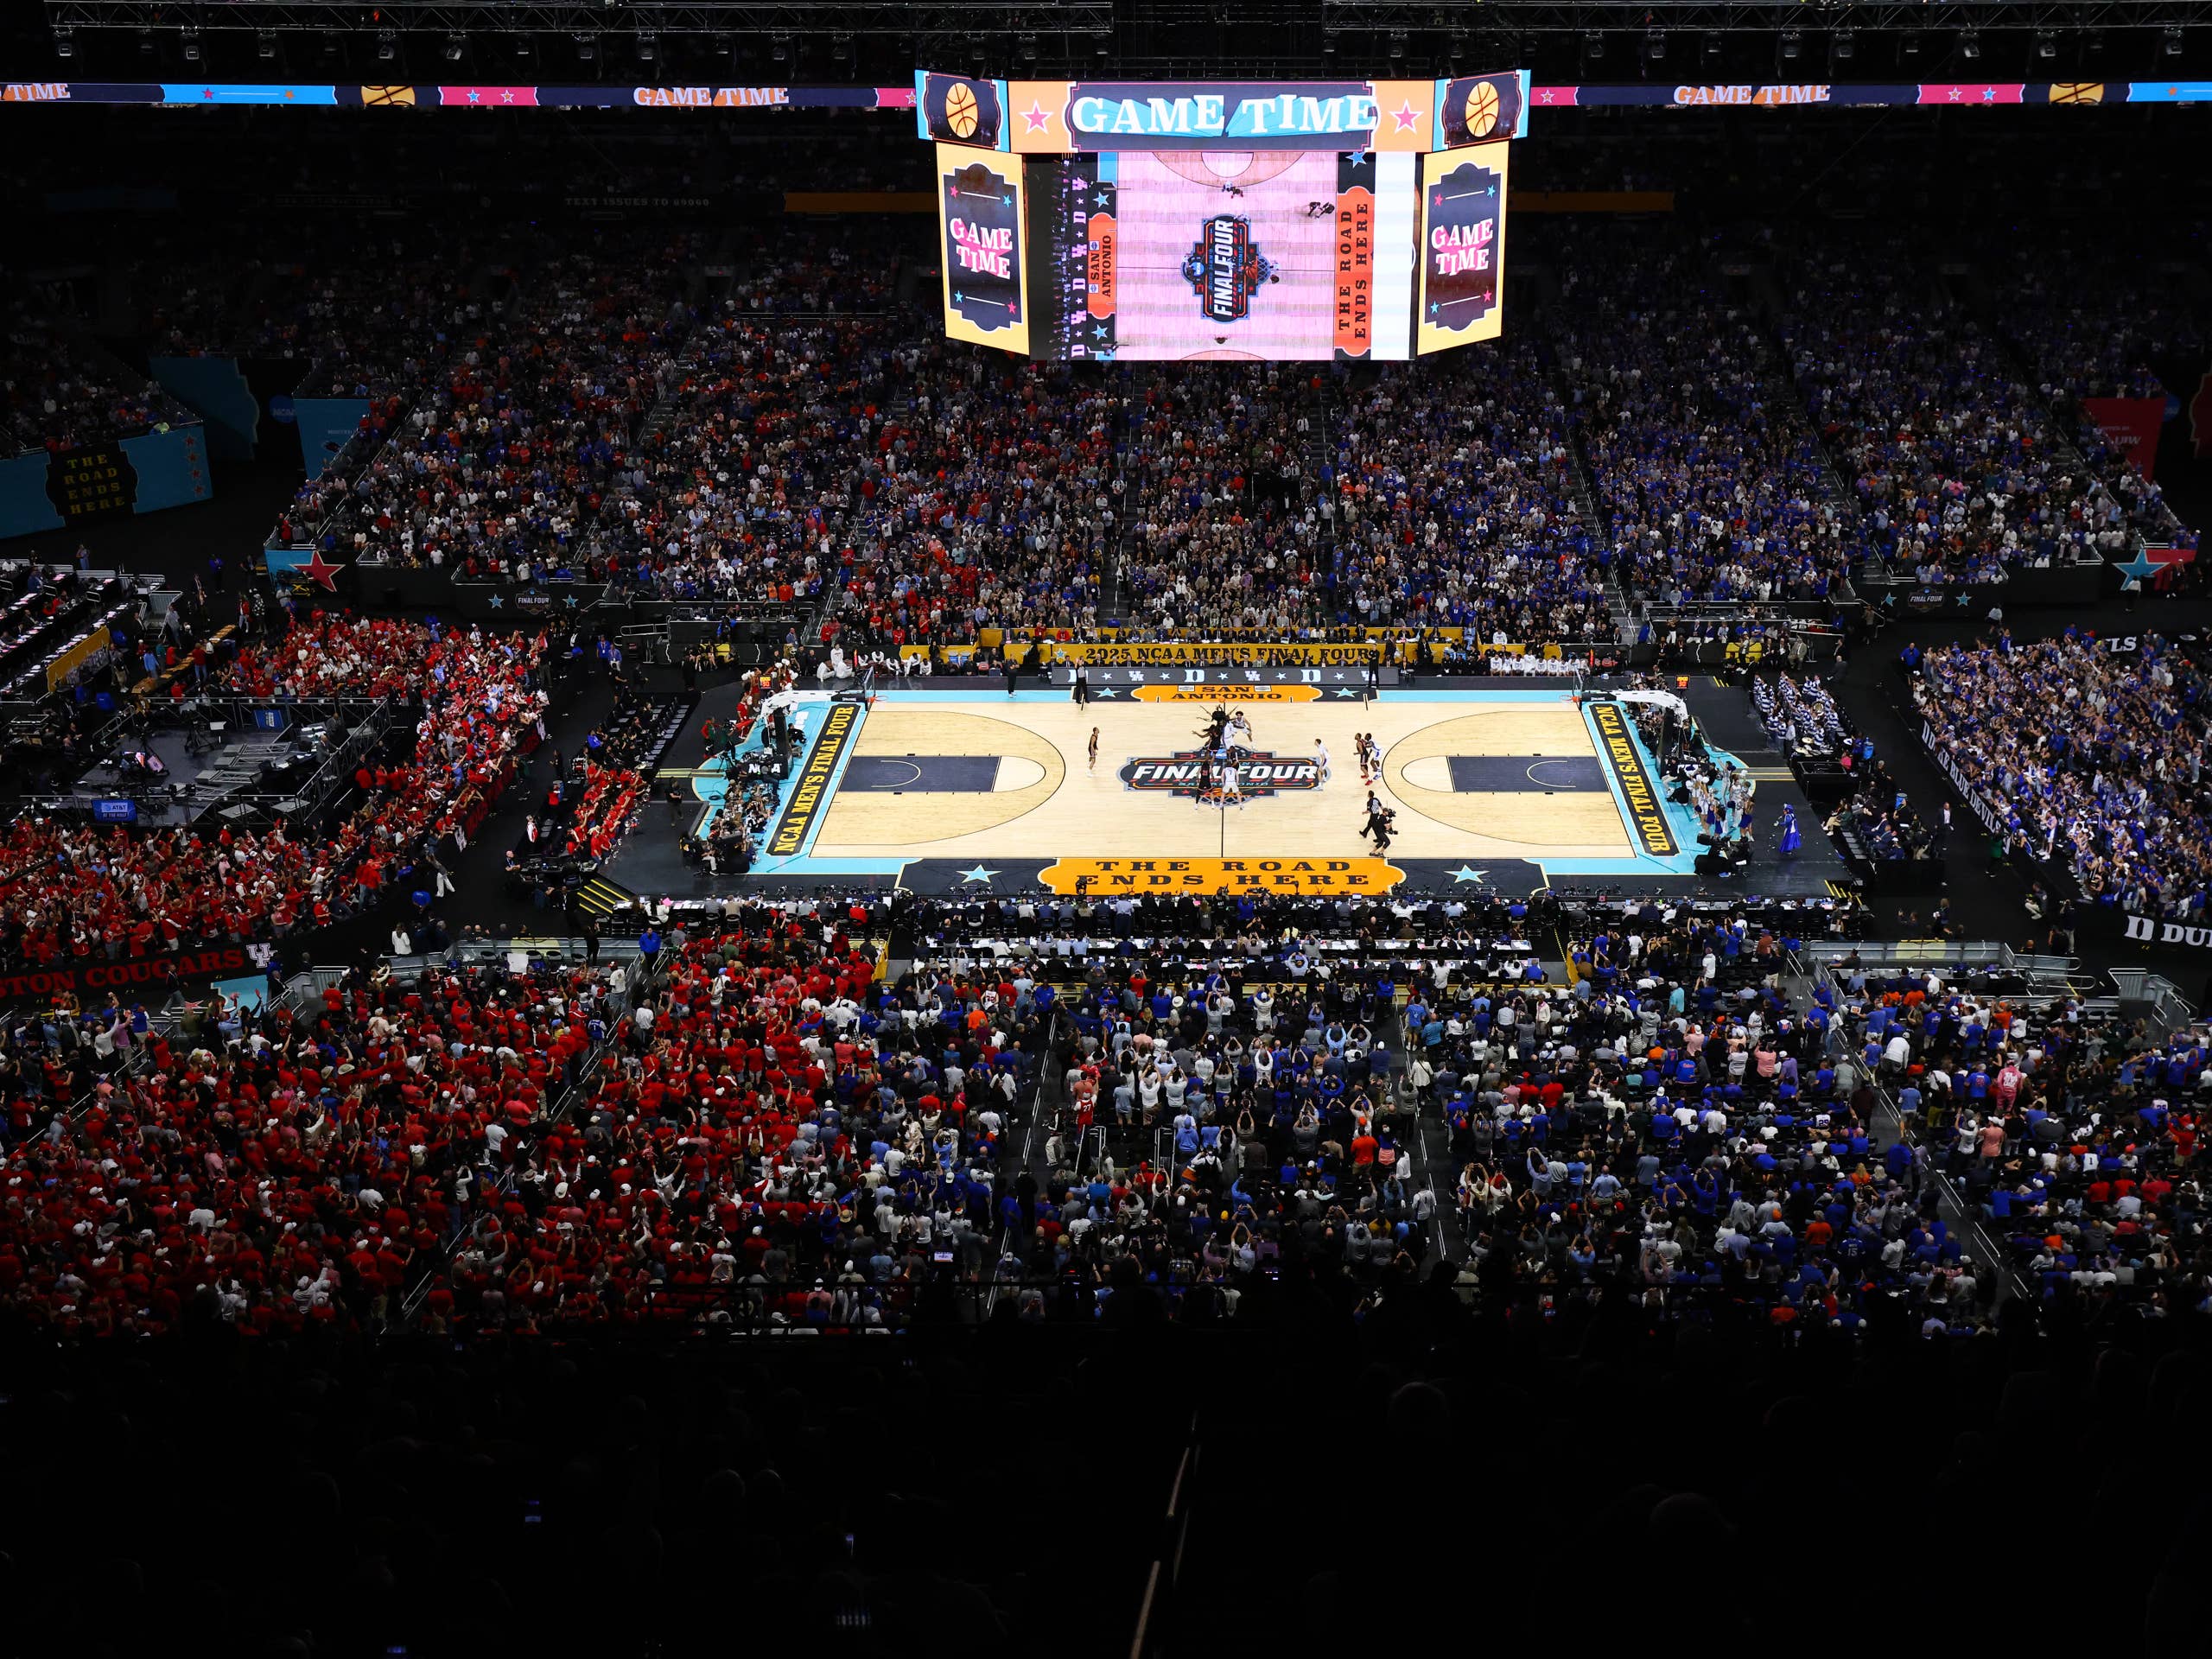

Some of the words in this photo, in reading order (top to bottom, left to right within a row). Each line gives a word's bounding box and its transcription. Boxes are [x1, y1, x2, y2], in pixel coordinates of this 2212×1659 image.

[7, 83, 71, 101] TIME
[633, 87, 712, 105] GAME
[720, 87, 789, 105] TIME
[1674, 86, 1752, 104] GAME
[1760, 85, 1831, 104] TIME
[1072, 95, 1225, 132] GAME
[1242, 94, 1378, 133] TIME
[950, 218, 1013, 250] GAME
[1215, 219, 1234, 268] FOUR
[1340, 211, 1352, 272] ROAD
[1357, 204, 1367, 265] HERE
[1431, 218, 1493, 249] GAME
[956, 245, 1010, 280] TIME
[1090, 252, 1100, 281] SAN
[1102, 235, 1111, 297] ANTONIO
[1435, 247, 1489, 276] TIME
[1214, 267, 1233, 316] FINAL
[1338, 286, 1351, 330] THE
[1355, 279, 1367, 339] ENDS
[63, 467, 118, 485] ROAD
[67, 454, 109, 468] THE
[68, 482, 120, 499] ENDS
[70, 496, 125, 514] HERE
[1085, 648, 1130, 659] 2025
[1137, 648, 1188, 659] NCAA
[1193, 648, 1250, 660] MEN'S
[1256, 648, 1313, 660] FINAL
[1320, 648, 1370, 660] FOUR
[1596, 706, 1623, 735] NCAA
[1607, 737, 1638, 773] MEN'S
[1927, 732, 1950, 772] DKE
[1949, 760, 1971, 800] BLUE
[774, 817, 808, 852] NCAA
[791, 775, 825, 813] MEN'S
[810, 738, 842, 773] FINAL
[826, 706, 855, 736] FOUR
[1623, 774, 1655, 813] FINAL
[1638, 815, 1671, 853] FOUR
[1077, 874, 1205, 886] ENDS
[1236, 874, 1369, 886] HERE
[1096, 861, 1190, 872] THE
[1222, 861, 1351, 872] ROAD
[2123, 915, 2155, 941] D
[86, 950, 245, 988] COUGARS
[1083, 1103, 1091, 1113] 27
